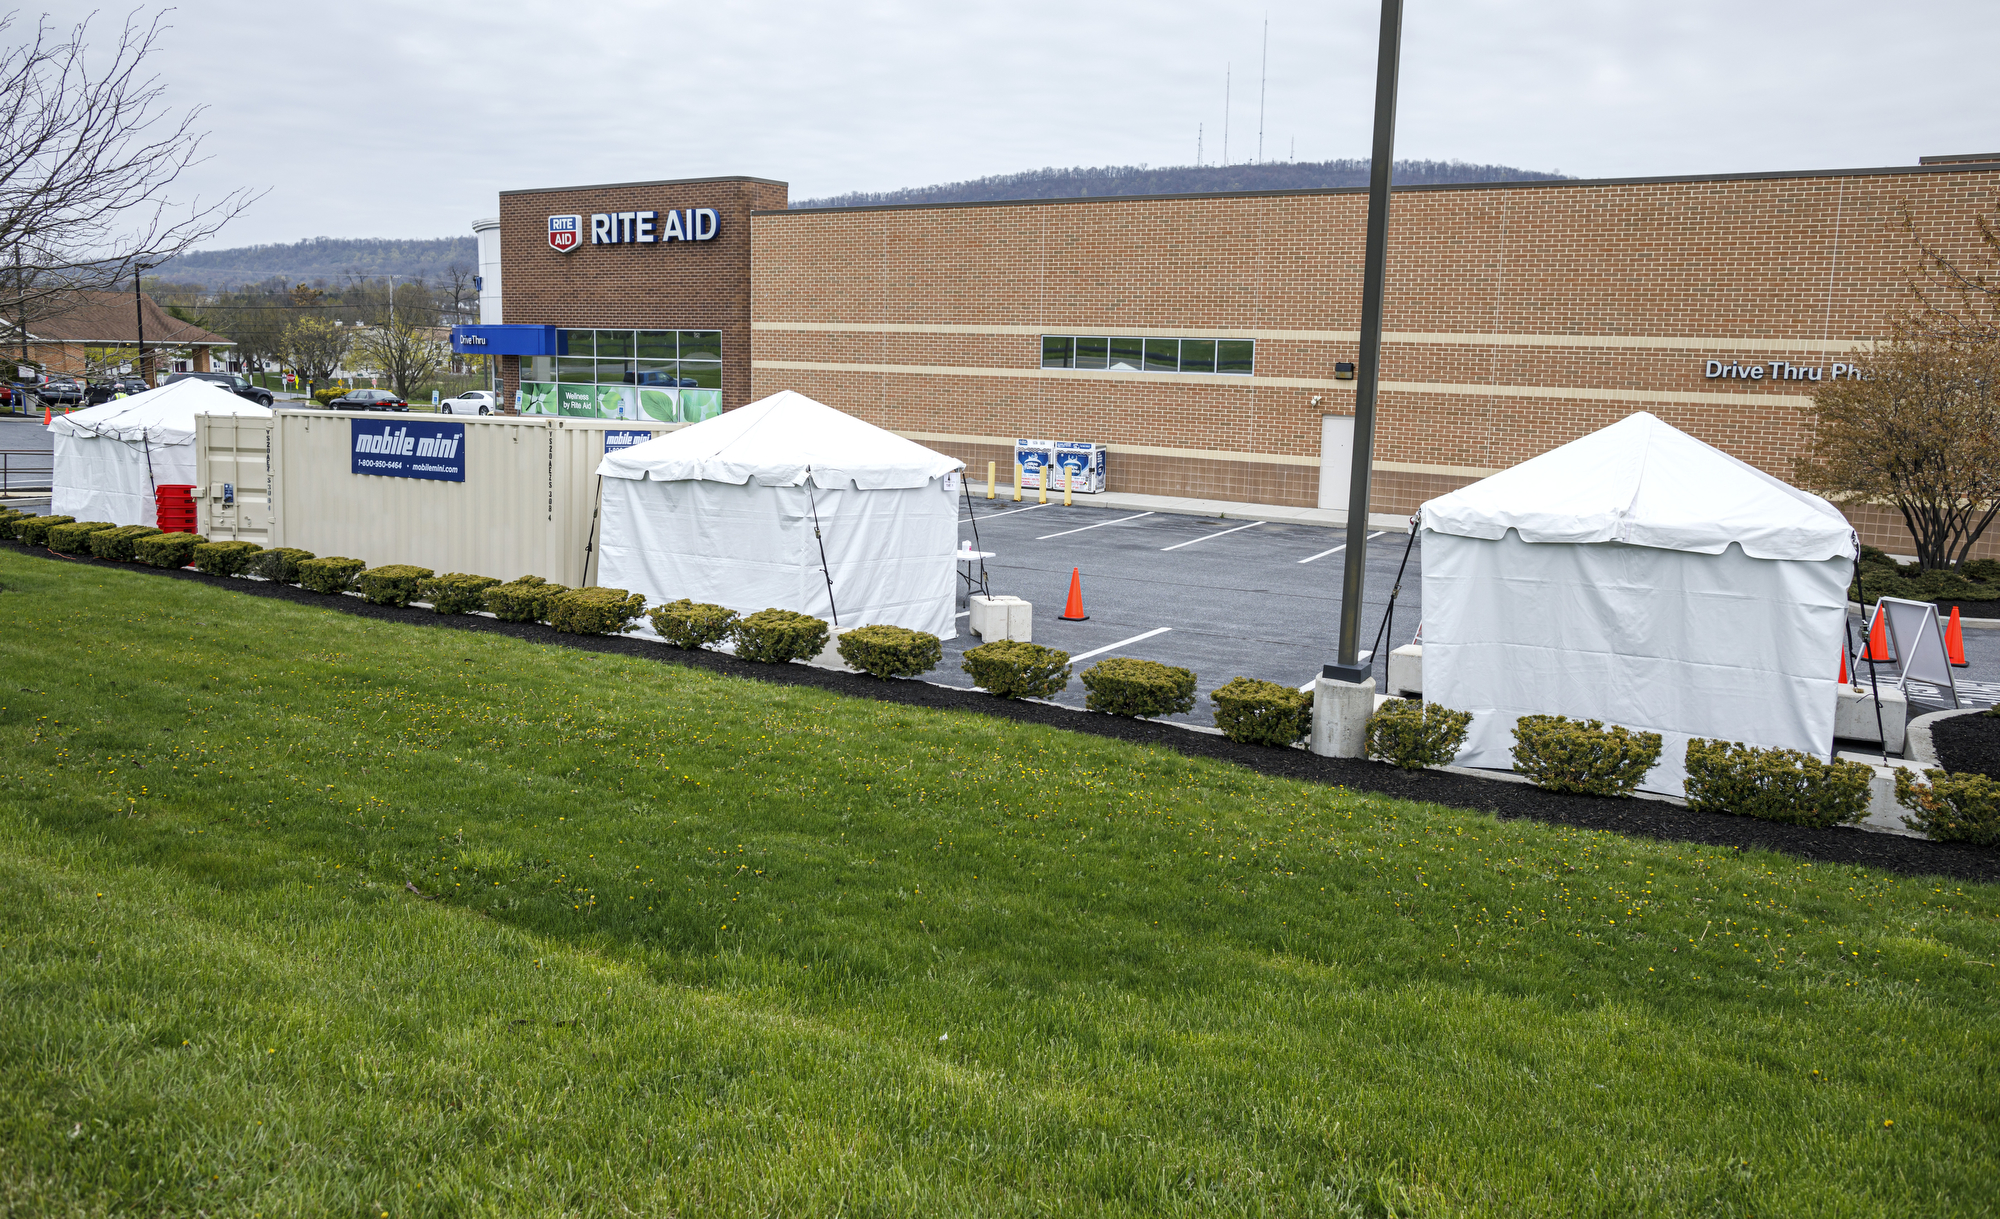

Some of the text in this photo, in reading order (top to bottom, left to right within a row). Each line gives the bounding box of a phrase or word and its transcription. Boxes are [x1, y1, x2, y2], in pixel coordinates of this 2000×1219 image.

[552, 218, 574, 230] RITE
[591, 208, 721, 244] RITE AID
[554, 233, 573, 246] AID
[460, 334, 487, 346] Drive Thru
[1705, 360, 1764, 380] Drive
[1768, 361, 1823, 381] Thru
[565, 391, 589, 401] Wellness
[563, 401, 592, 410] by Rite Aid
[355, 426, 460, 458] mobile mini
[606, 431, 633, 445] mobile
[358, 459, 458, 474] 1-800-950-6464 mobilemini.com
